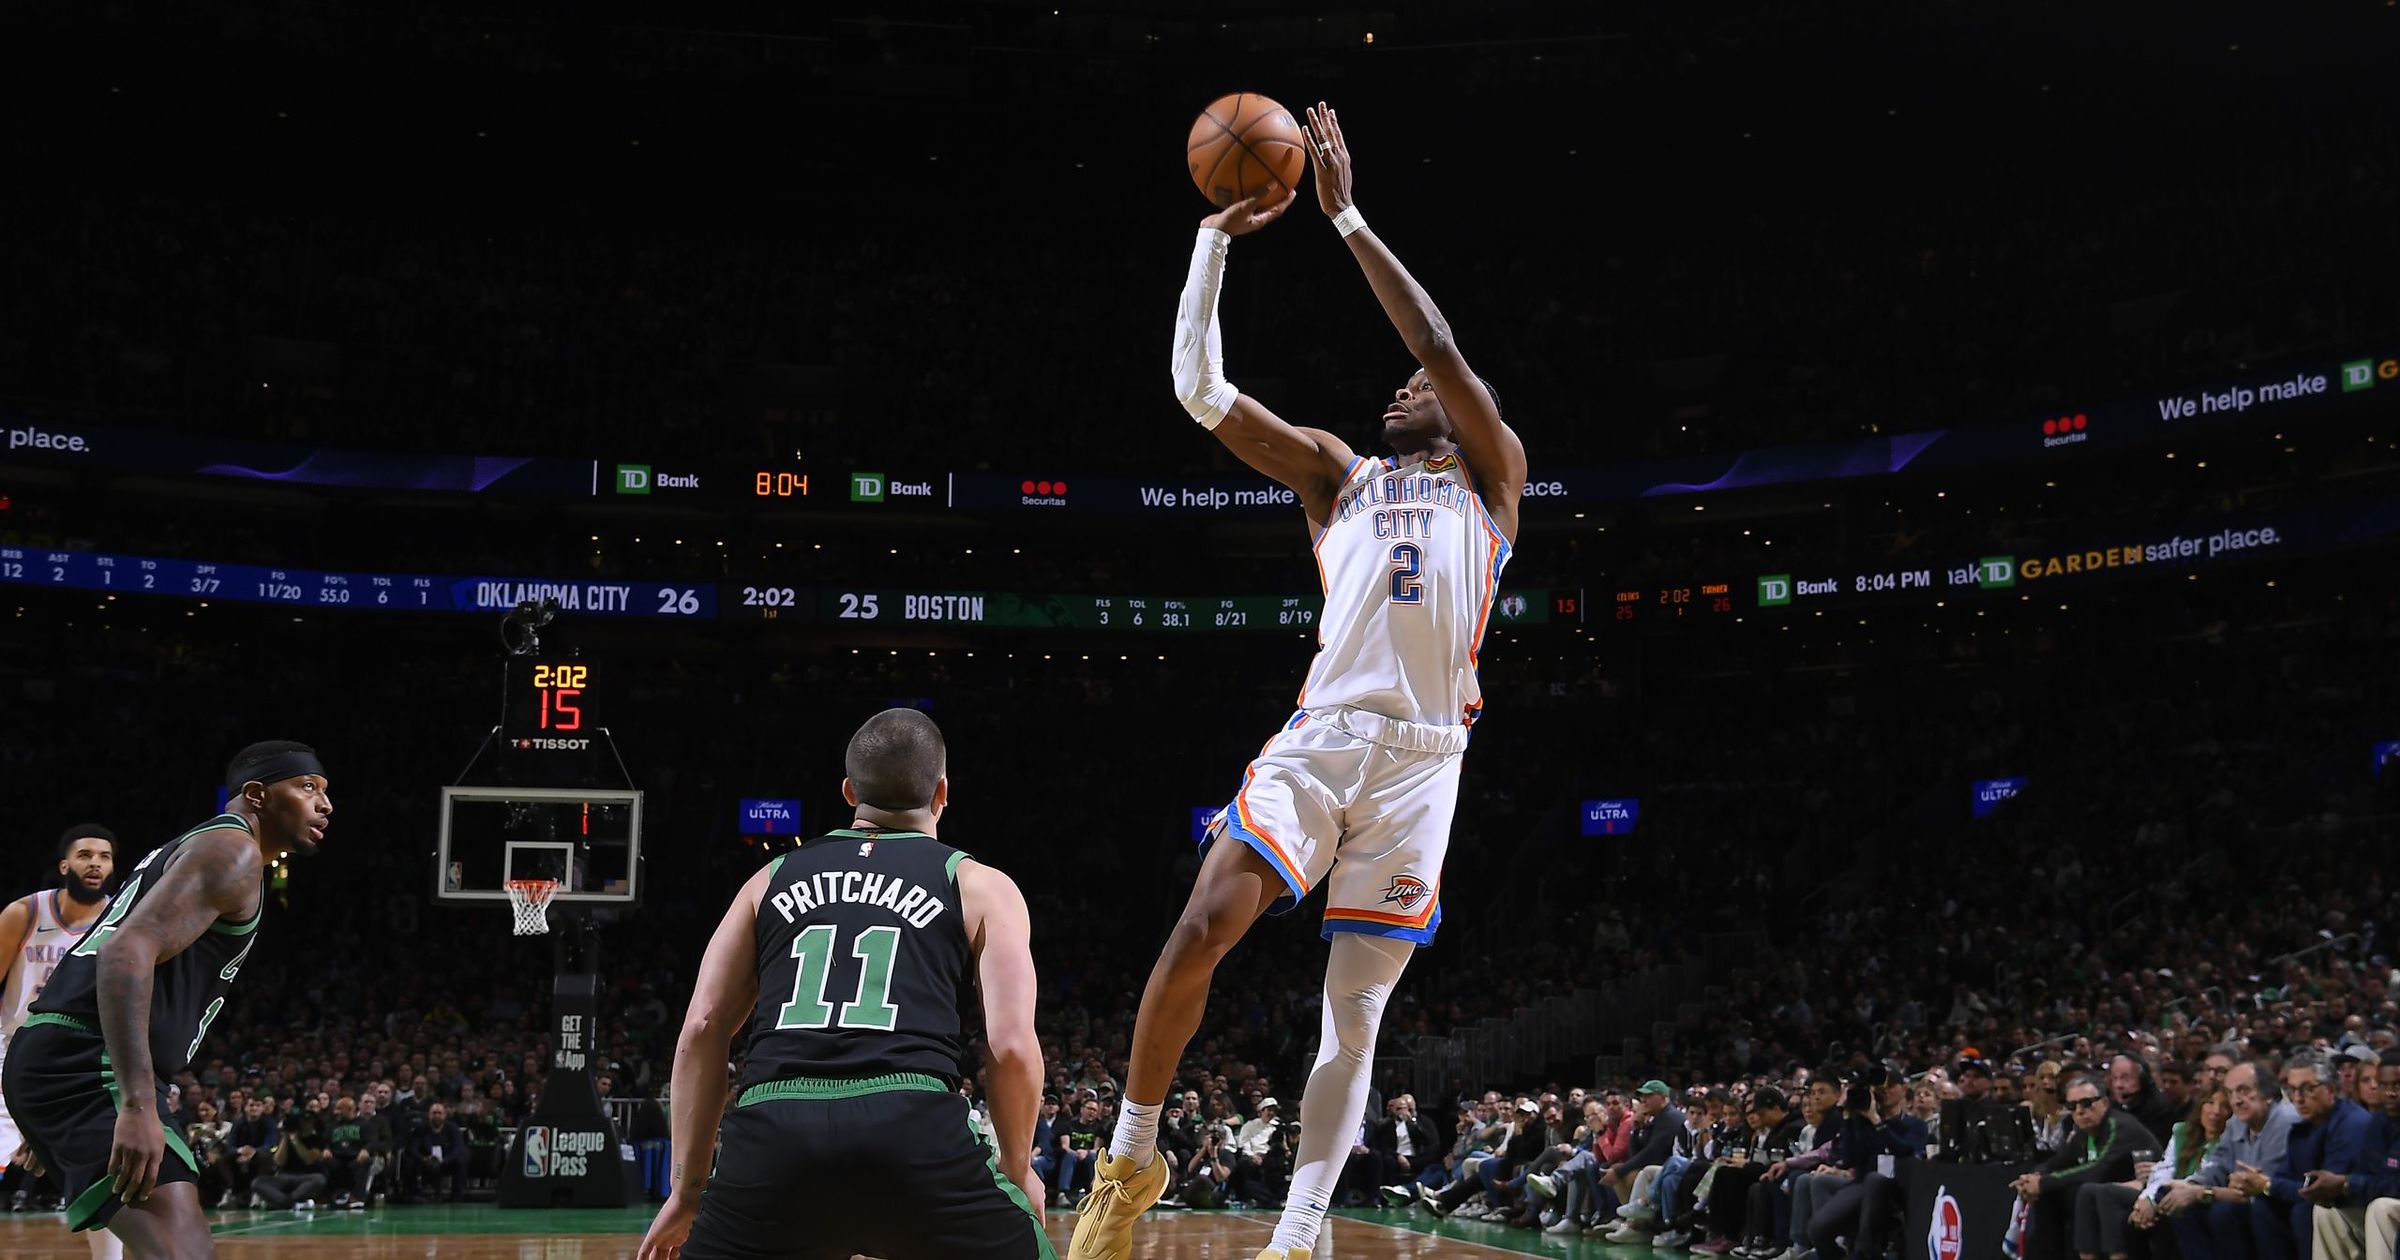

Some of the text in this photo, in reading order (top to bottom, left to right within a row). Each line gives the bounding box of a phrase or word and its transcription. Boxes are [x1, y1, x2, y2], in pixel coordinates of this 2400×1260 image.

[2344, 365, 2372, 385] TD
[2159, 374, 2327, 421] We help make
[10, 427, 90, 452] place.
[2044, 432, 2086, 447] Securitas
[620, 470, 699, 488] TD Bank
[756, 472, 807, 496] 8:04
[854, 477, 932, 496] TD Bank
[1522, 481, 1568, 497] ace.
[1022, 496, 1066, 507] Securitas
[1140, 486, 1294, 510] We help make
[1337, 475, 1469, 523] OKLAHOMA
[1372, 508, 1435, 540] CITY
[2145, 527, 2281, 562] safer place.
[48, 553, 70, 563] AST
[97, 557, 115, 567] STL
[141, 561, 157, 570] TO
[271, 571, 286, 581] FG
[324, 575, 347, 585] FG%
[373, 577, 392, 586] TOL
[414, 578, 431, 587] FLS
[1983, 543, 2144, 582] TD GARDEN
[3, 563, 427, 605] 12 2 1 2 3/7 11/20 55.0 6 1
[1388, 541, 1424, 607] 2
[1855, 570, 1931, 592] 8:04 PM
[1948, 563, 1981, 585] ak
[477, 582, 699, 615] OKLAHOMA CITY 26
[743, 587, 795, 607] 2:02
[1761, 578, 1838, 600] TD Bank
[763, 608, 778, 619] 1st
[839, 593, 984, 621] 25 BOSTON
[1096, 599, 1299, 610] FLS TOL FG% FG 3PT
[1557, 599, 1575, 613] 15
[1100, 610, 1312, 627] 3 6 38.1 8/21 8/19
[534, 665, 587, 688] 2:02
[541, 689, 580, 729] 15
[532, 738, 590, 750] TISSOT
[749, 809, 790, 819] ULTRA
[1590, 809, 1629, 820] ULTRA
[771, 871, 944, 929] PRITCHARD
[25, 944, 67, 963] OKLA
[775, 924, 901, 1031] 11
[561, 1015, 582, 1032] GET
[562, 1033, 581, 1050] THE
[564, 1051, 585, 1071] App
[551, 1127, 605, 1154] League
[551, 1152, 587, 1176] Pass
